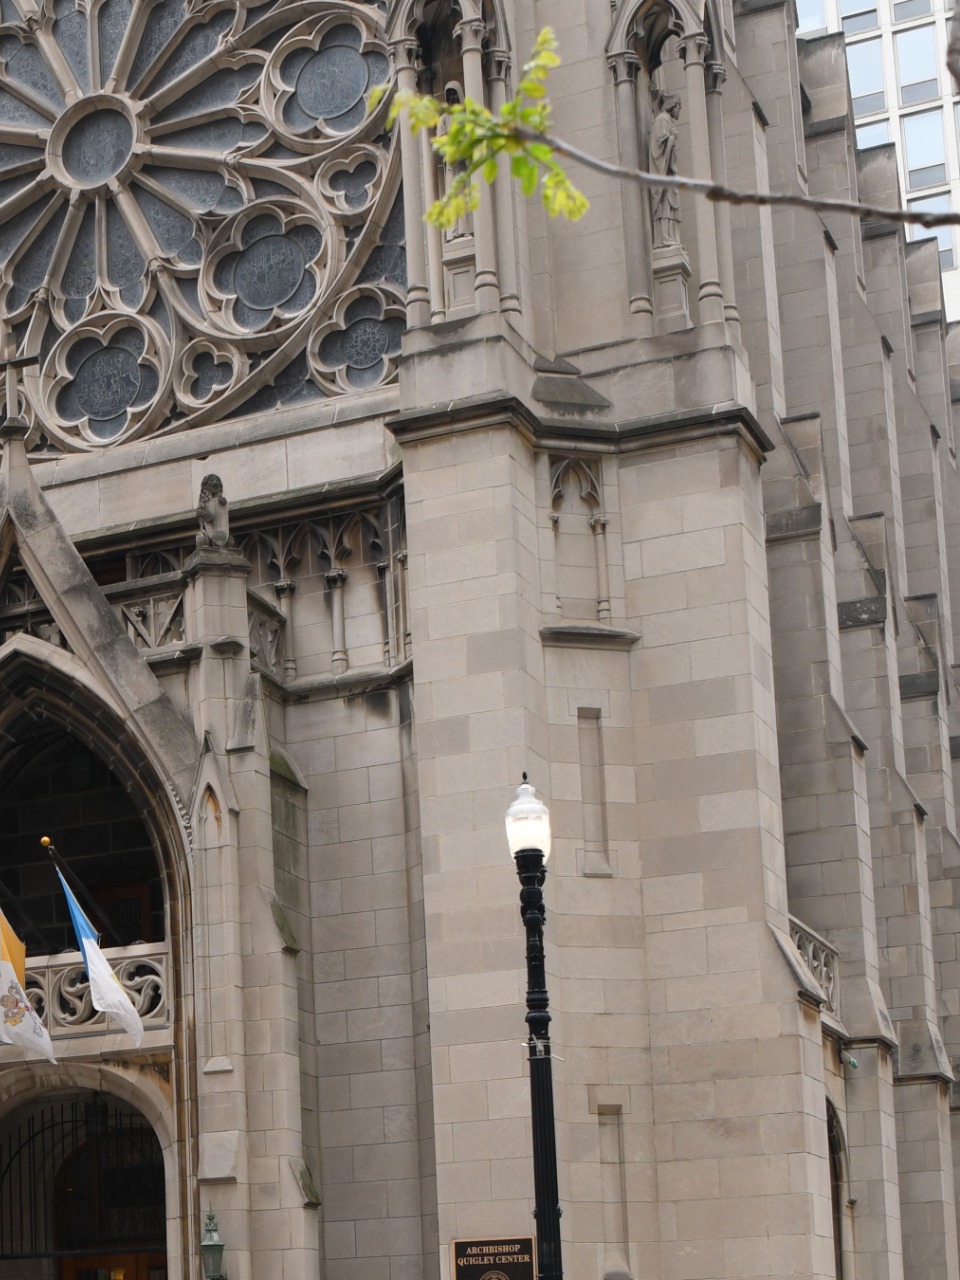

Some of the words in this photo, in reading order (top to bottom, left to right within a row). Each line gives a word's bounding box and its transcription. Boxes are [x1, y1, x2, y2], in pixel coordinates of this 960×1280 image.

[466, 1244, 521, 1255] ARCHBISHOP
[457, 1256, 495, 1267] QUIGLEY
[496, 1254, 530, 1264] CENTER
